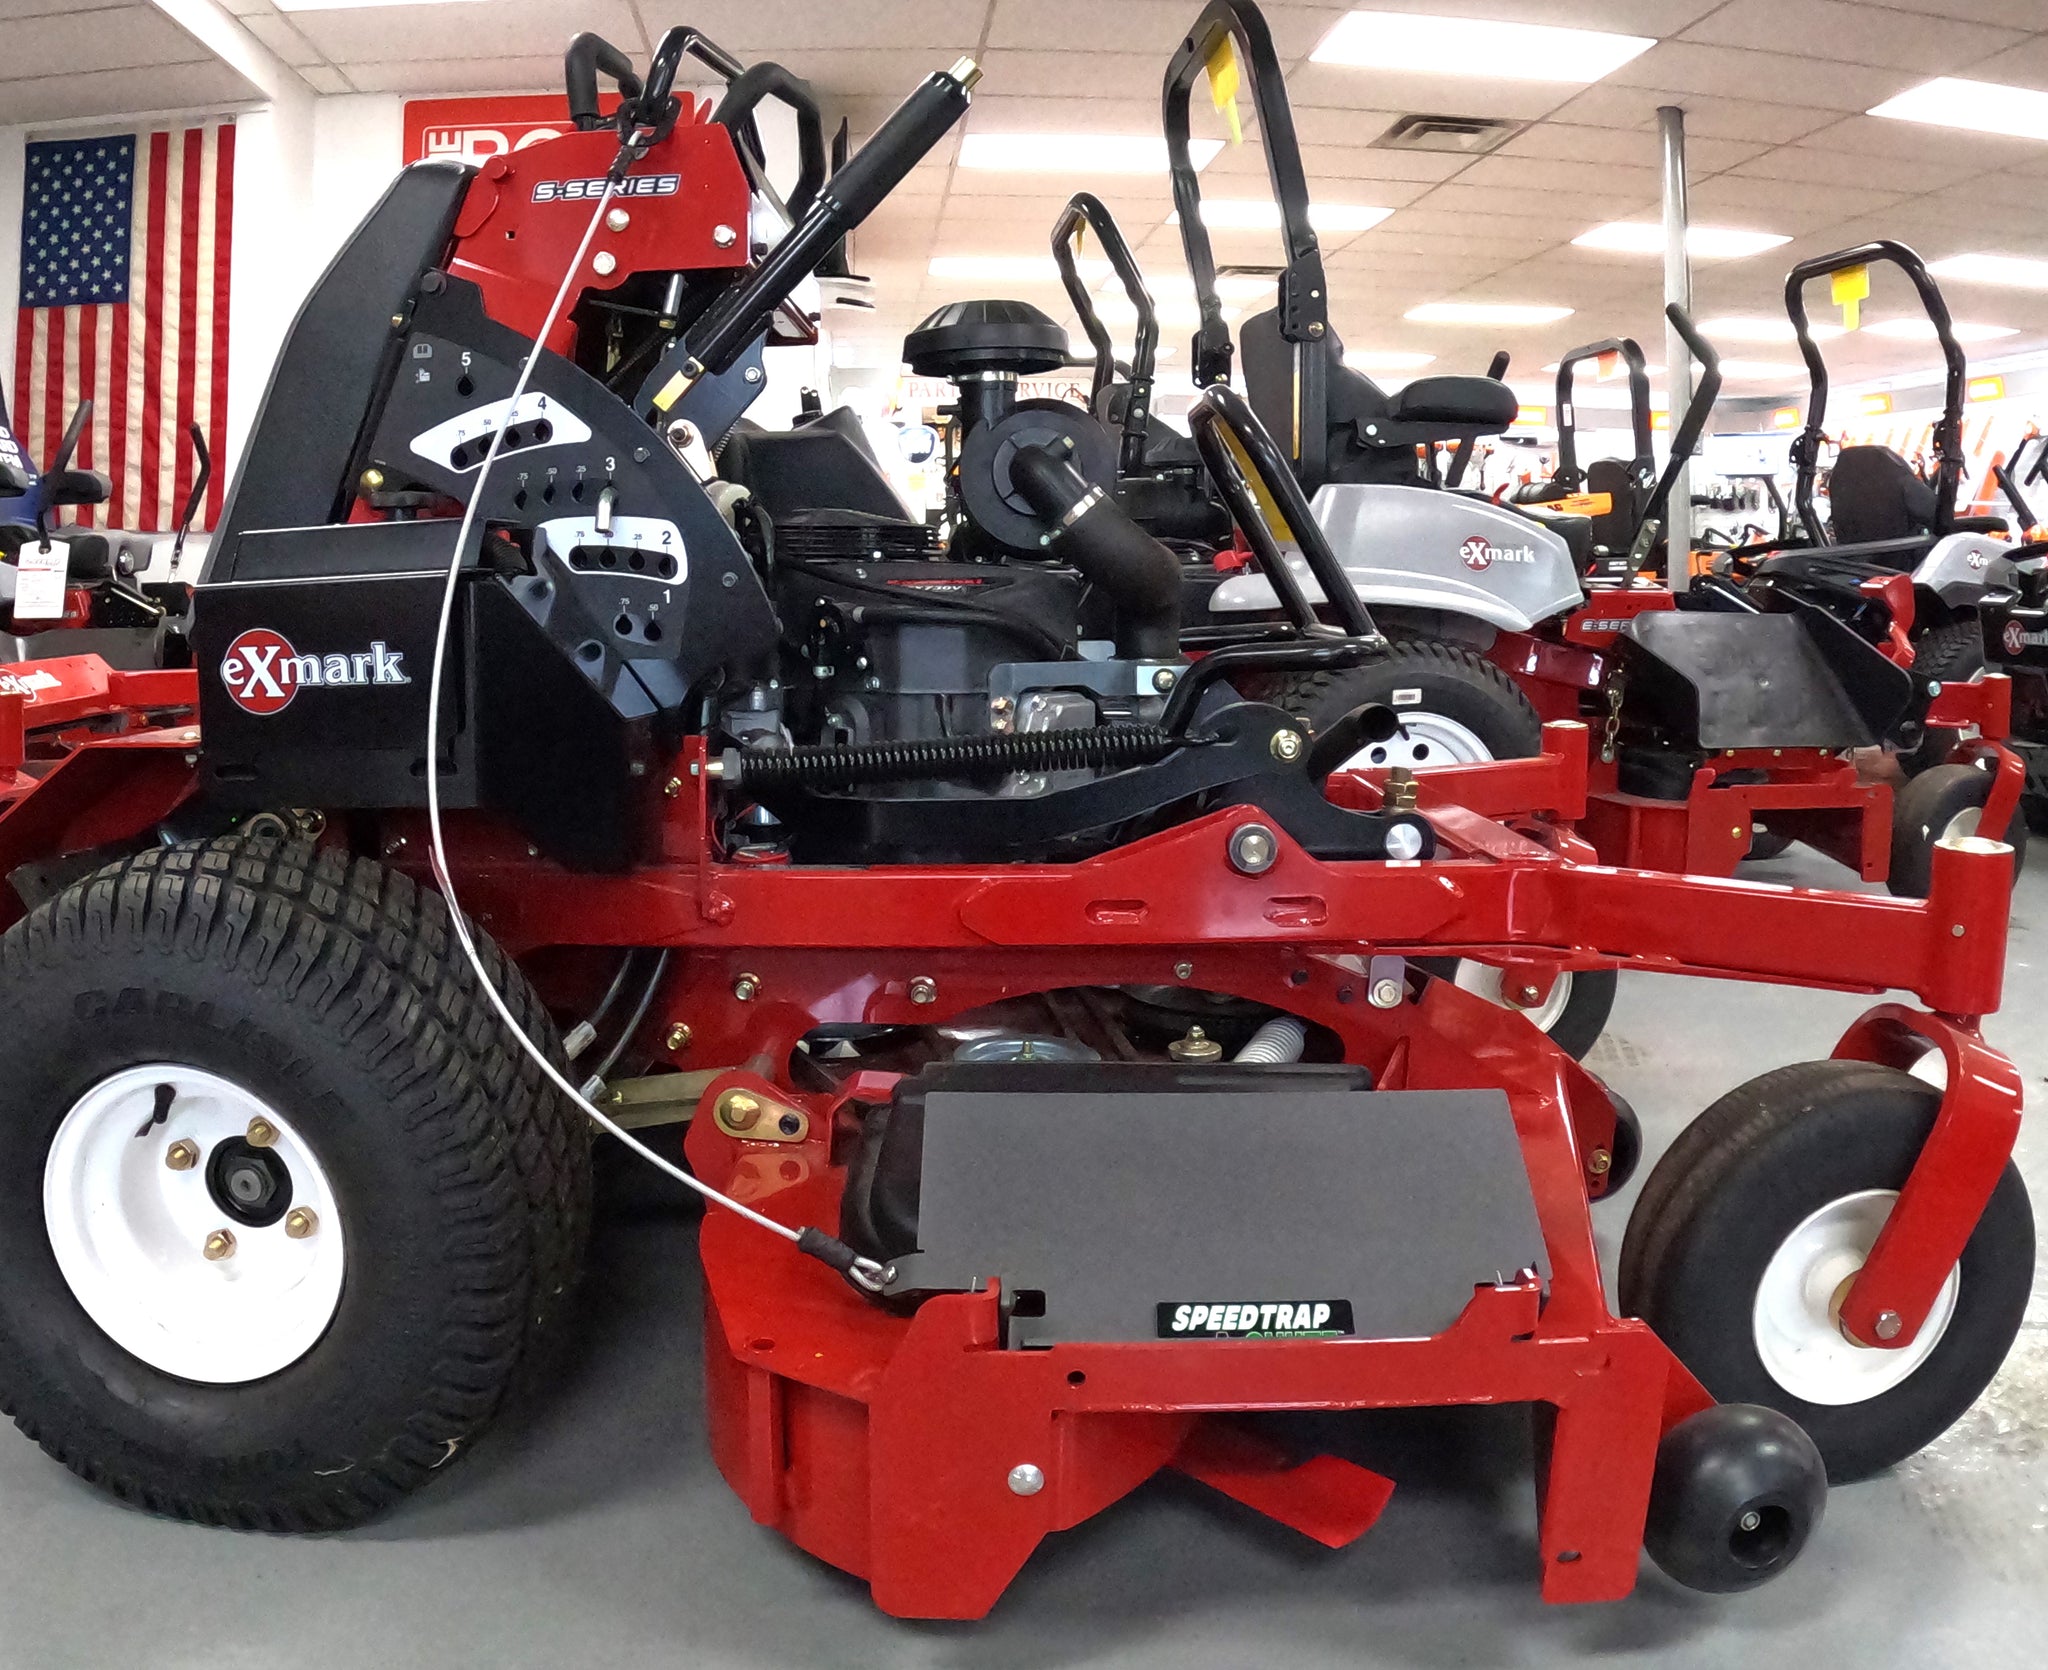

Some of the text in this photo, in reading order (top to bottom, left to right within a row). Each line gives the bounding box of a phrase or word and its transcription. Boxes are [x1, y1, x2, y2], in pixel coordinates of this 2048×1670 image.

[534, 176, 678, 200] S-SERIES
[461, 351, 472, 366] 5
[537, 396, 547, 411] 4
[517, 472, 528, 480] .75
[575, 465, 587, 473] .25
[605, 456, 616, 472] 3
[661, 530, 672, 545] 2
[618, 597, 630, 605] .75
[662, 589, 671, 604] 1
[1172, 1303, 1331, 1331] SPEEDTRAP
